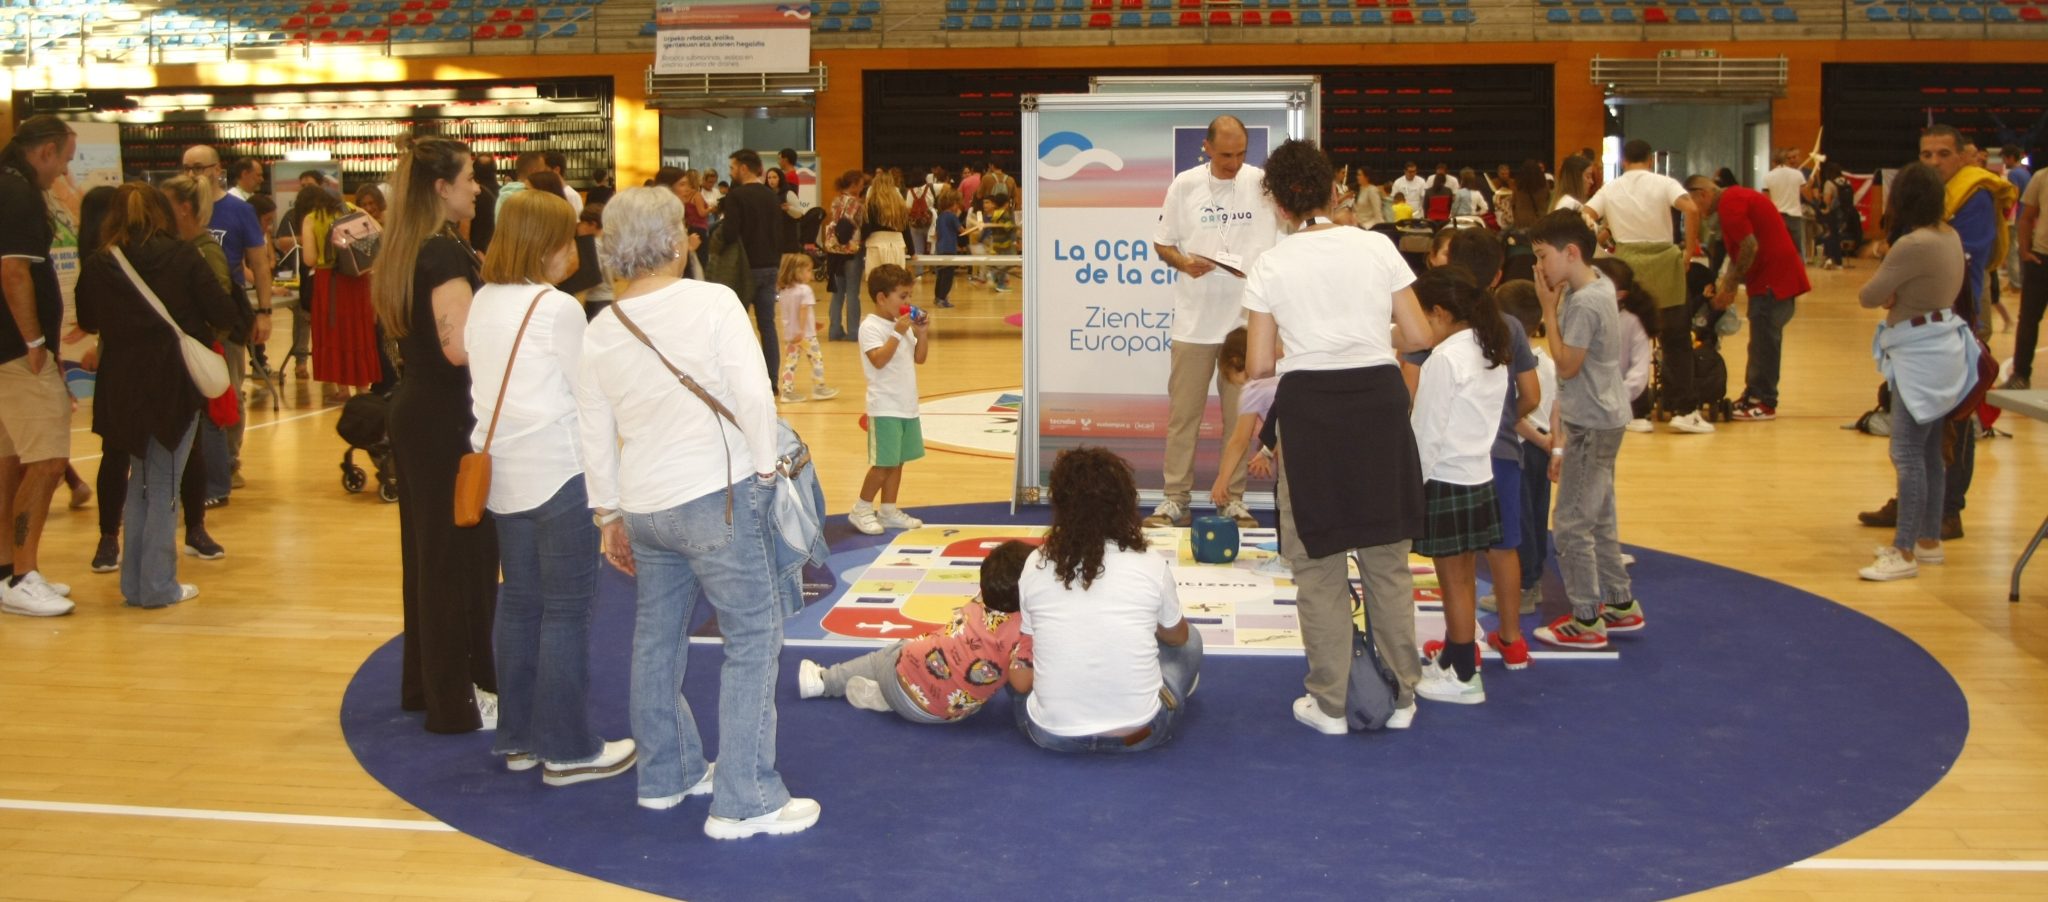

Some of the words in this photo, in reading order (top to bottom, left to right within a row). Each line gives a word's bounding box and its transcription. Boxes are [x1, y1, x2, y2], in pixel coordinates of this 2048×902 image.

[1054, 239, 1085, 261] La
[1094, 239, 1148, 262] OCA
[1075, 262, 1109, 285] de
[1117, 263, 1143, 285] la
[1085, 306, 1176, 329] Zientzi
[1070, 329, 1172, 357] Europak
